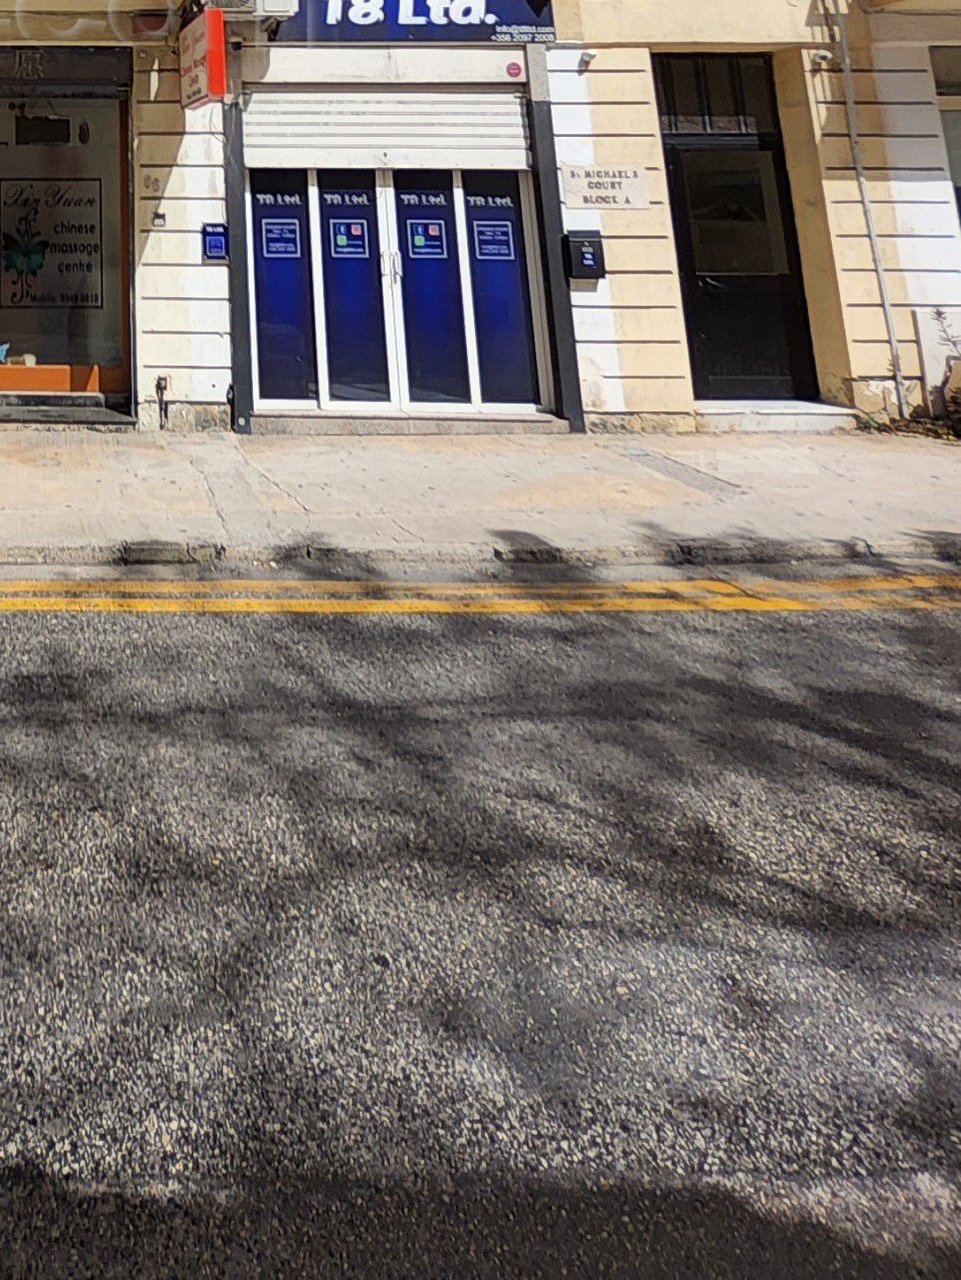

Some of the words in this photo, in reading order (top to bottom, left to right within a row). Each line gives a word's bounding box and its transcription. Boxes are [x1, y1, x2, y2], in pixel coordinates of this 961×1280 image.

[587, 181, 623, 190] COURT
[582, 195, 619, 204] BLOCK
[624, 195, 631, 204] A
[53, 220, 96, 235] chinese
[49, 242, 99, 256] massage
